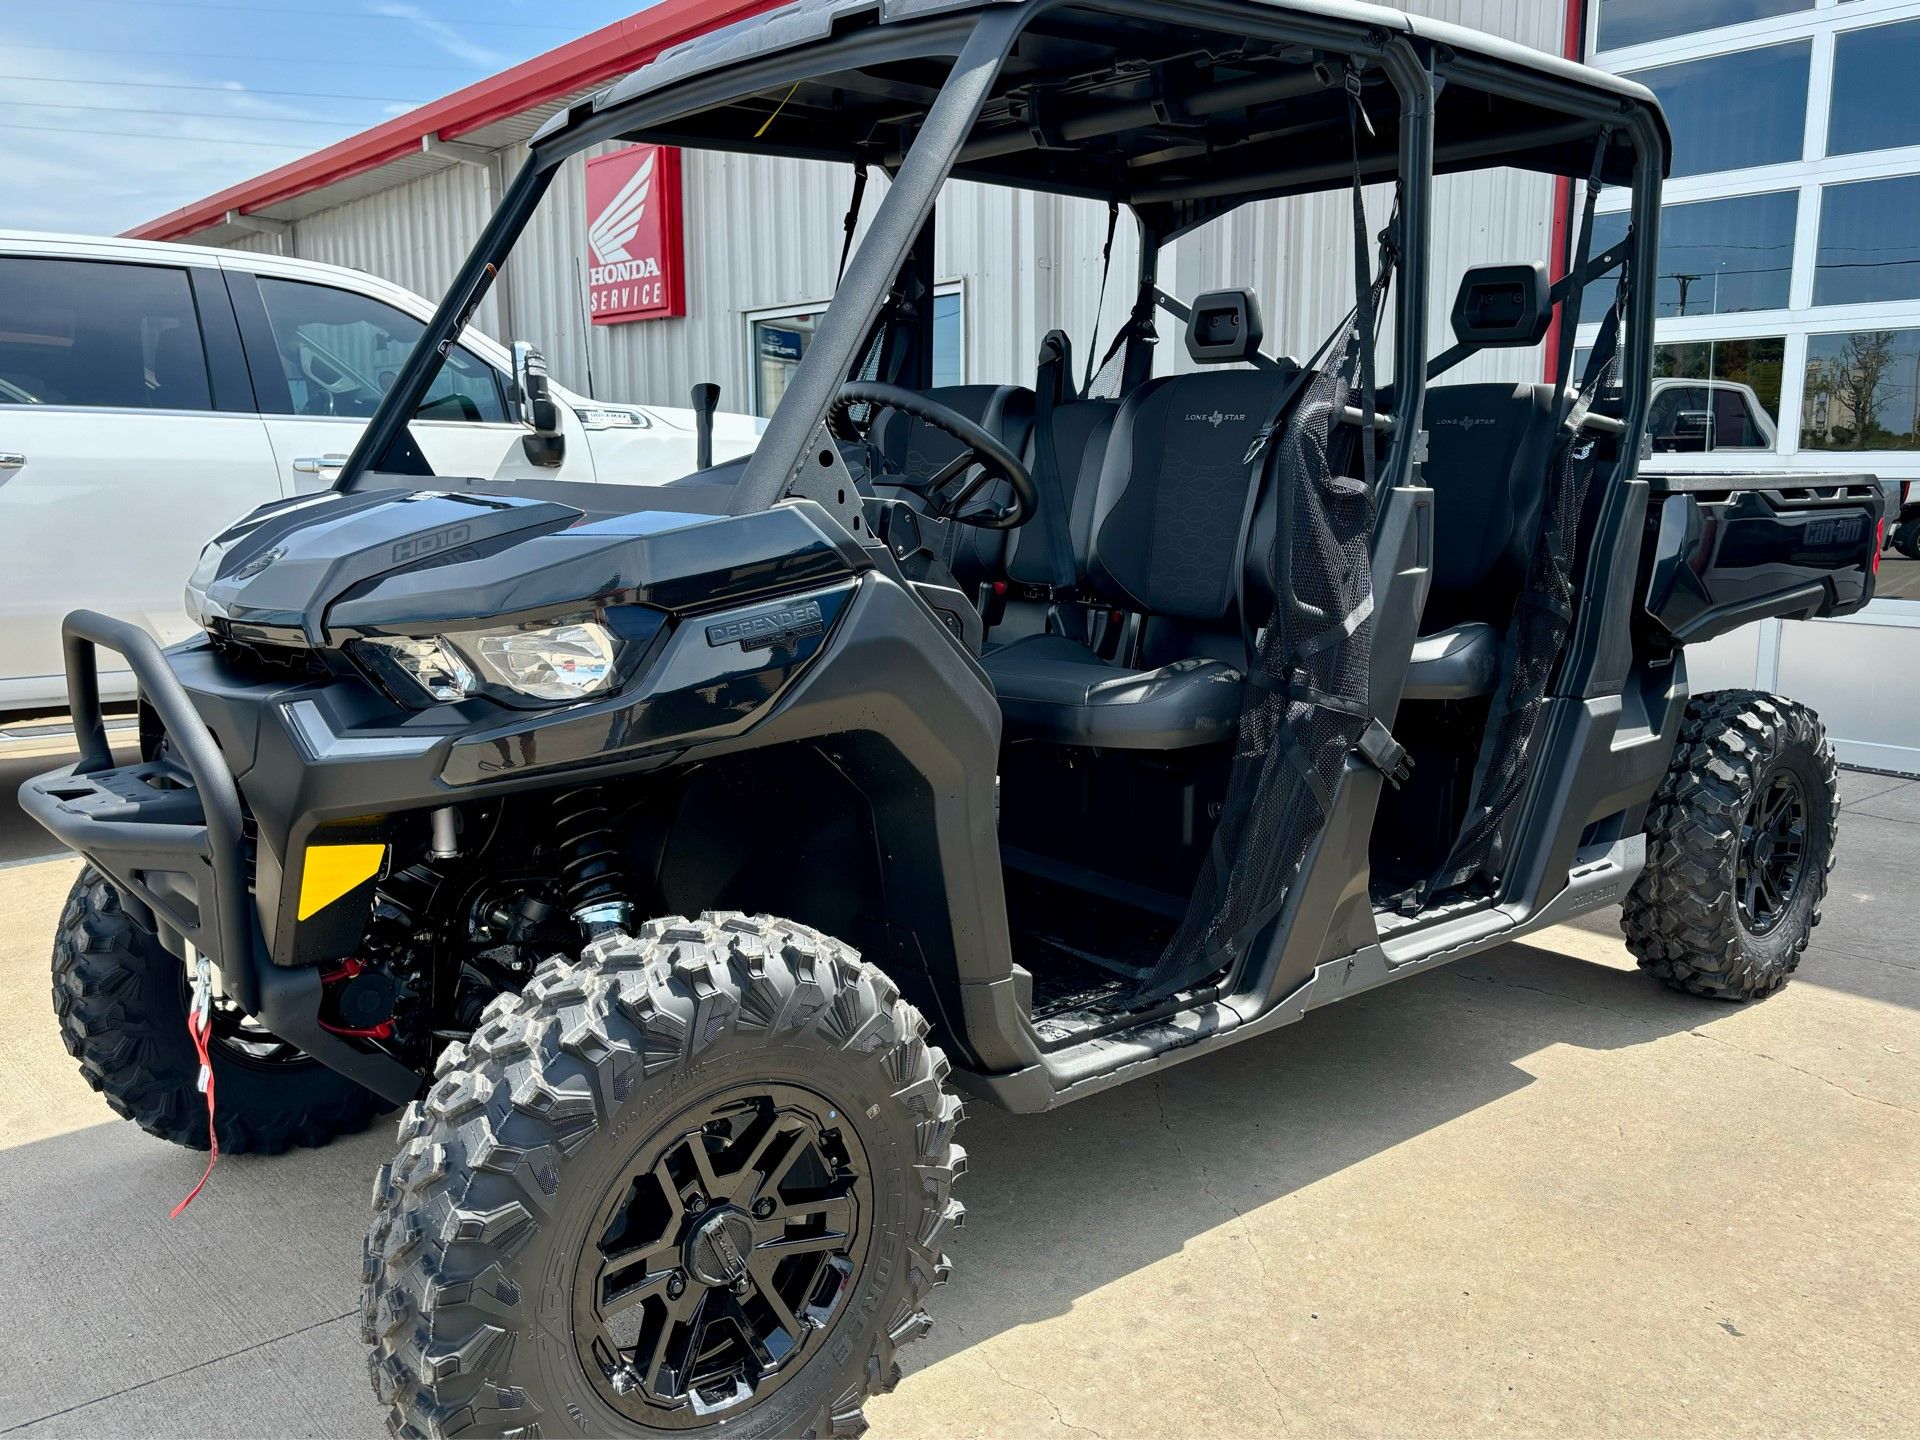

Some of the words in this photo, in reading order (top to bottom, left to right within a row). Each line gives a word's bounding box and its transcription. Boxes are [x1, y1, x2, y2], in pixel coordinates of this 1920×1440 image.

[590, 258, 660, 286] HONDA
[590, 282, 661, 312] SERVICE
[1184, 413, 1208, 422] LONE
[1223, 413, 1246, 422] STAR
[1435, 418, 1458, 426] LONE
[1474, 418, 1497, 426] STAR
[710, 605, 822, 641] DEFENDER
